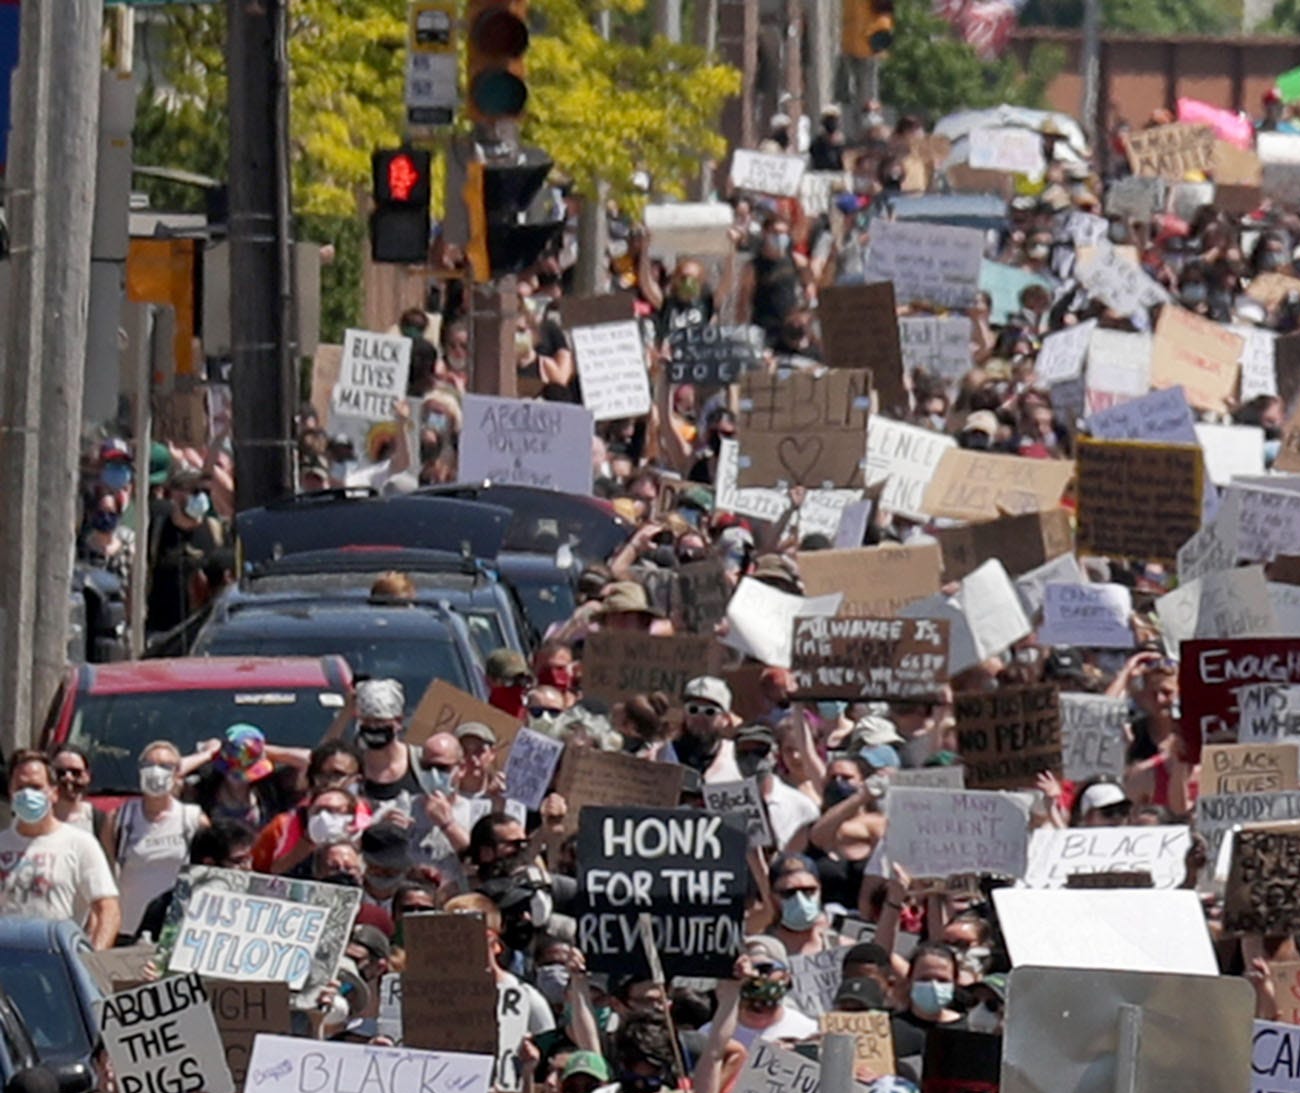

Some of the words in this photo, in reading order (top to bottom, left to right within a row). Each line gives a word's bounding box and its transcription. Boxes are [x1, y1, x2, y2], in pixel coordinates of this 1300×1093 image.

[352, 338, 398, 362] BLACK
[351, 365, 395, 388] LIVES
[995, 721, 1057, 748] PEACE
[1213, 751, 1280, 771] BLACK
[603, 817, 723, 860] HONK
[1060, 832, 1185, 859] BLACK
[586, 870, 655, 906] FOR
[661, 869, 734, 905] THE
[185, 896, 327, 943] JUSTICE
[209, 933, 313, 980] FLOYD
[101, 972, 209, 1032] ABOLISH
[118, 1020, 185, 1064] THE
